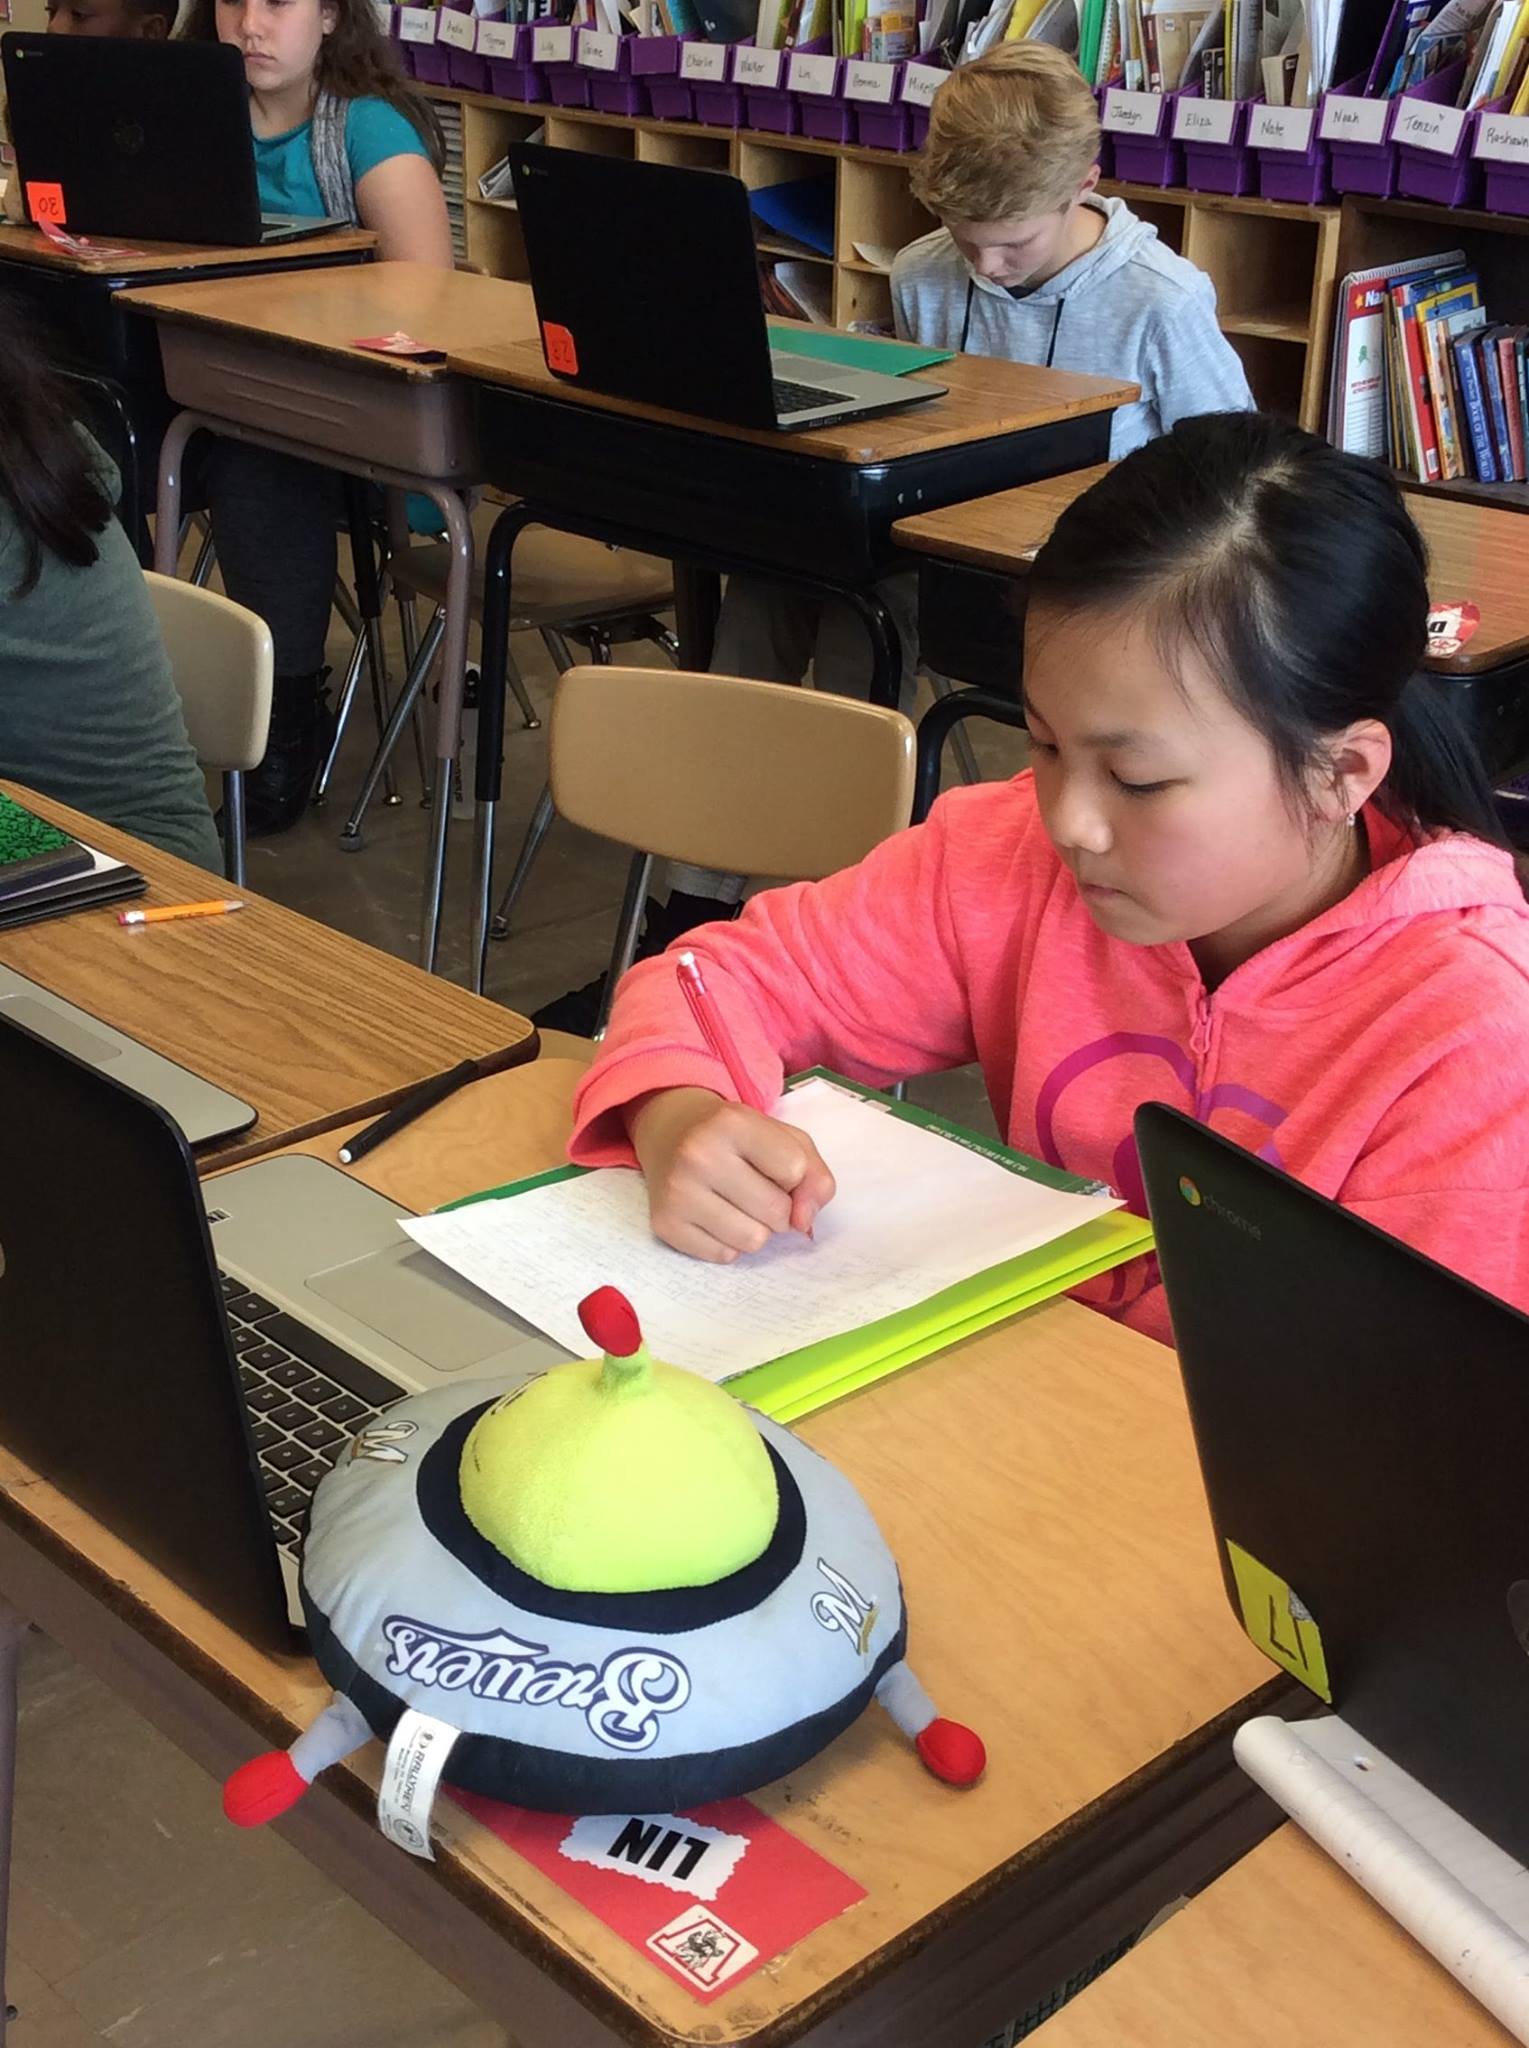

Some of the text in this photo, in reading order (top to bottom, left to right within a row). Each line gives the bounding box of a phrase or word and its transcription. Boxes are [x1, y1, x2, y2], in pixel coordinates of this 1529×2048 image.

[1185, 113, 1212, 127] Eliza
[1333, 110, 1360, 124] Noah
[1404, 114, 1440, 134] Tenzin
[1260, 119, 1285, 137] Nate
[38, 196, 60, 217] 30
[382, 1614, 692, 1752] Brewers
[607, 1817, 711, 1881] LIN
